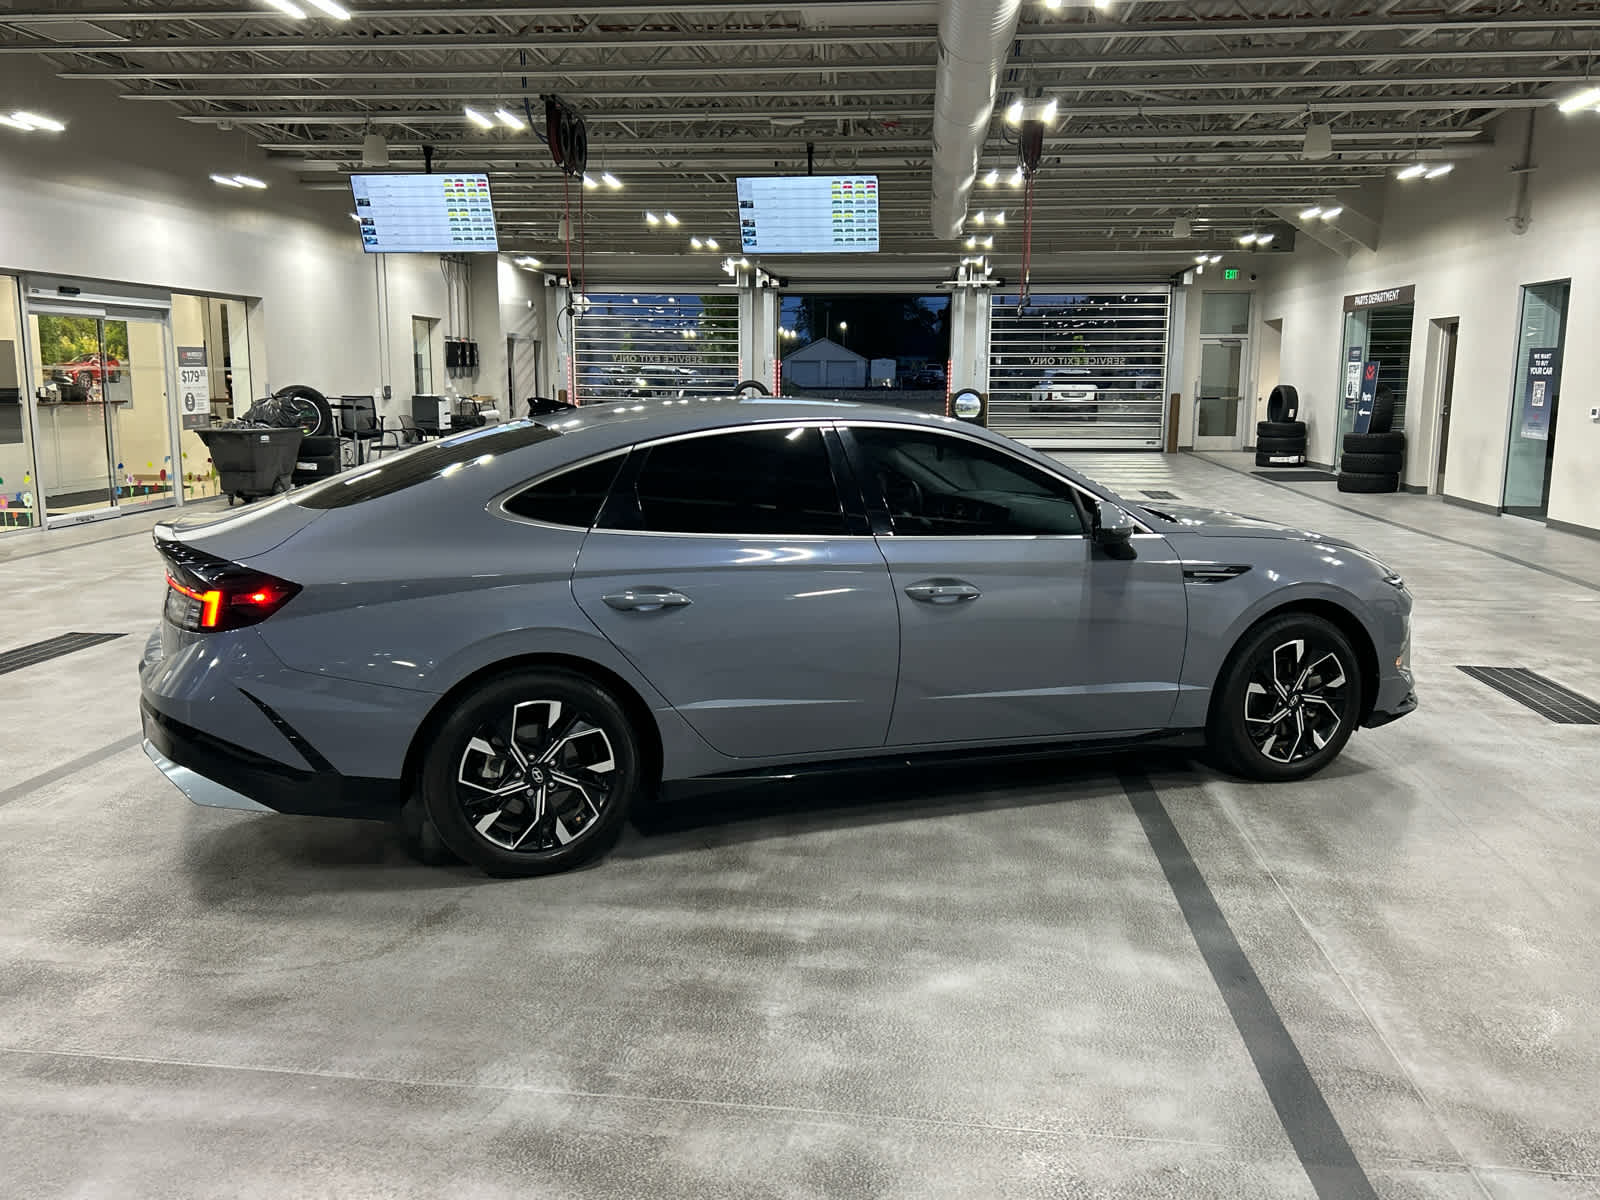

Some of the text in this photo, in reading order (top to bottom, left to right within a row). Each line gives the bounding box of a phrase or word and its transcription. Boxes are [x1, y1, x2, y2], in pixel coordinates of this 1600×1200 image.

[1225, 269, 1240, 281] EXIT
[1354, 289, 1400, 306] PARTS DEPARTMENT
[1530, 367, 1553, 376] YOUR CAR
